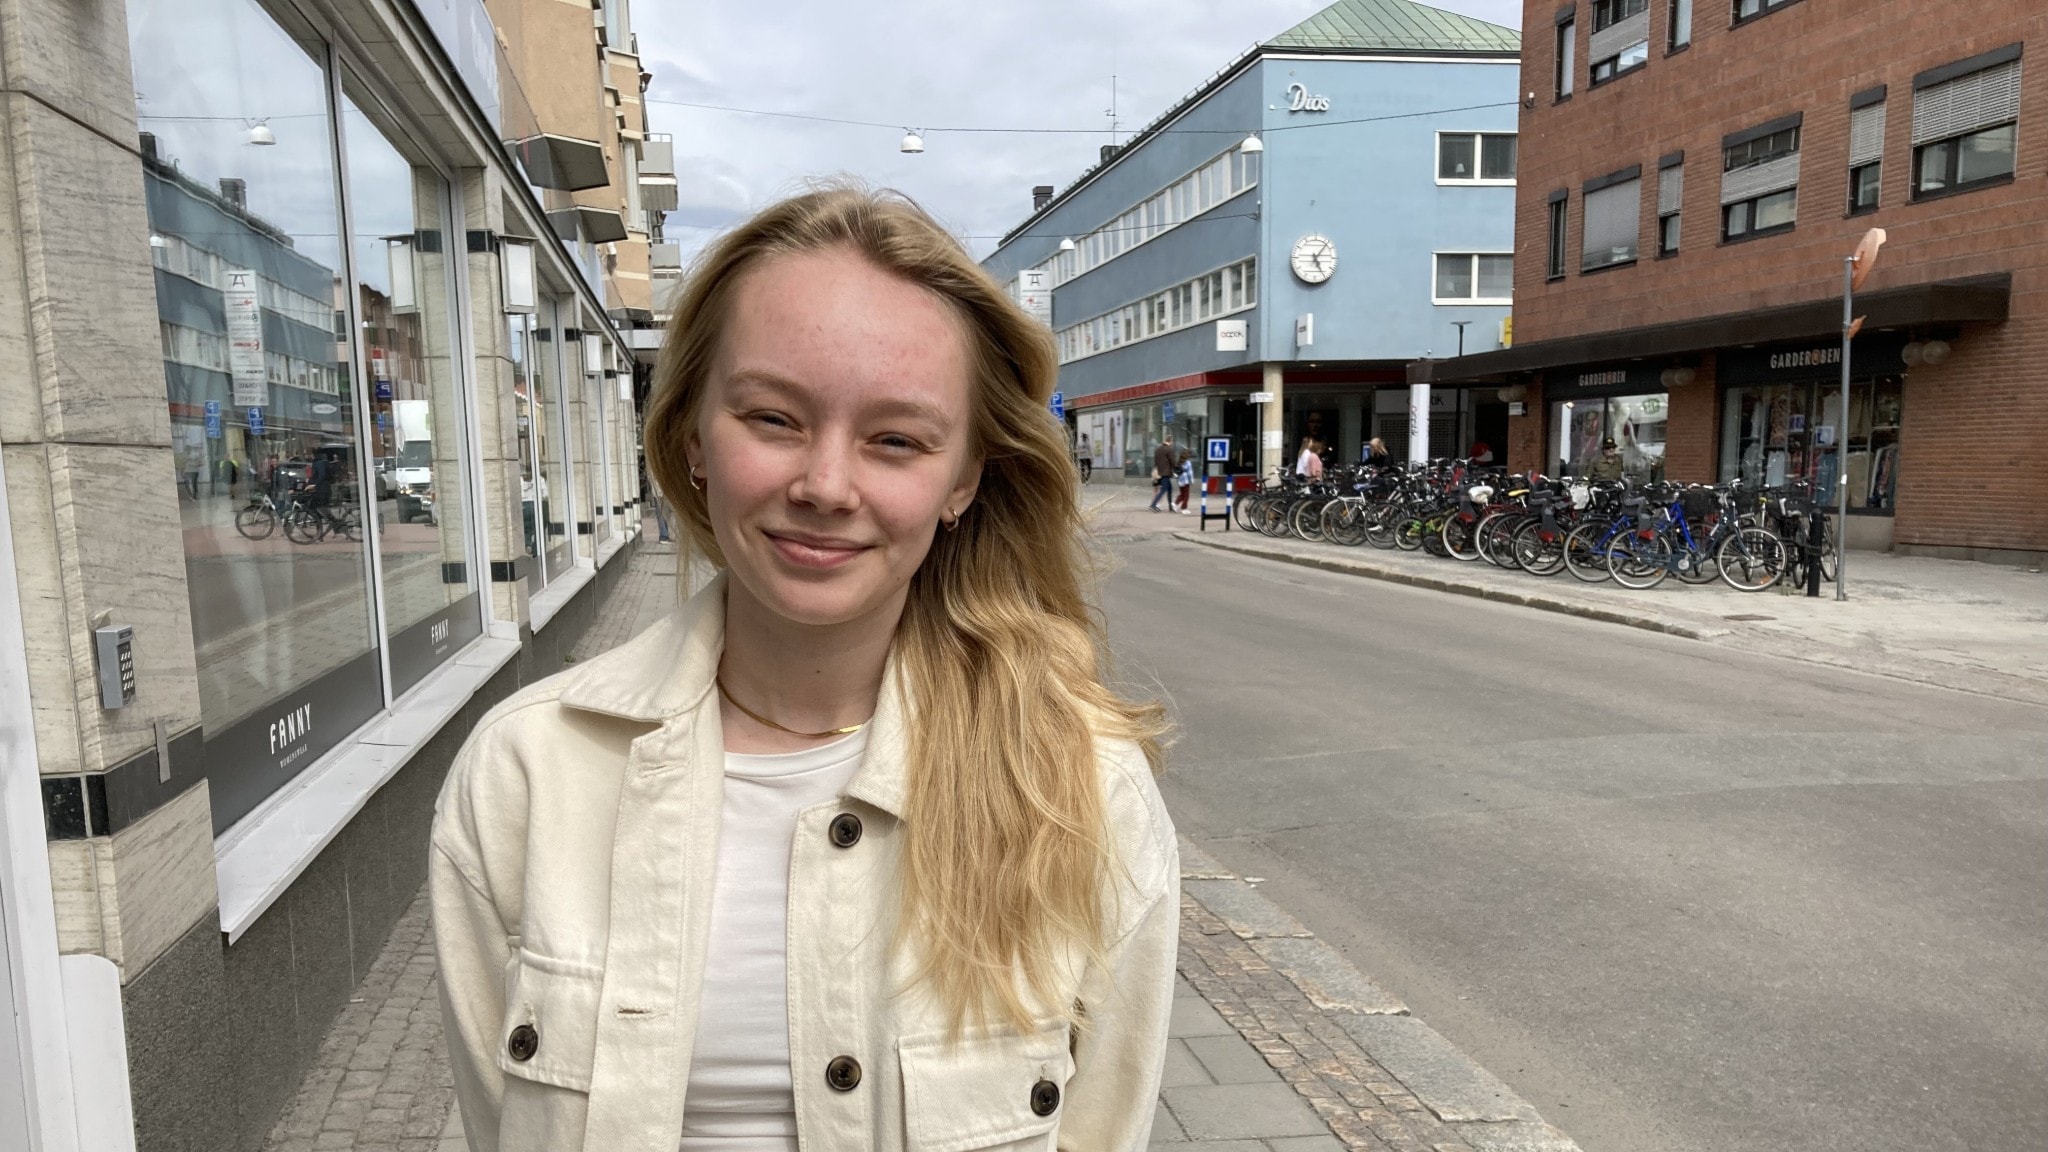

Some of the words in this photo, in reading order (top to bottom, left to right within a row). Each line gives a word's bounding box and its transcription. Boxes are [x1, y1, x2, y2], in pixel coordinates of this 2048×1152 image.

[1770, 348, 1840, 369] GARDEROBEN
[1579, 371, 1626, 387] GARDEROBEN
[1053, 394, 1060, 405] P
[431, 618, 449, 646] FANNY
[270, 703, 311, 755] FANNY
